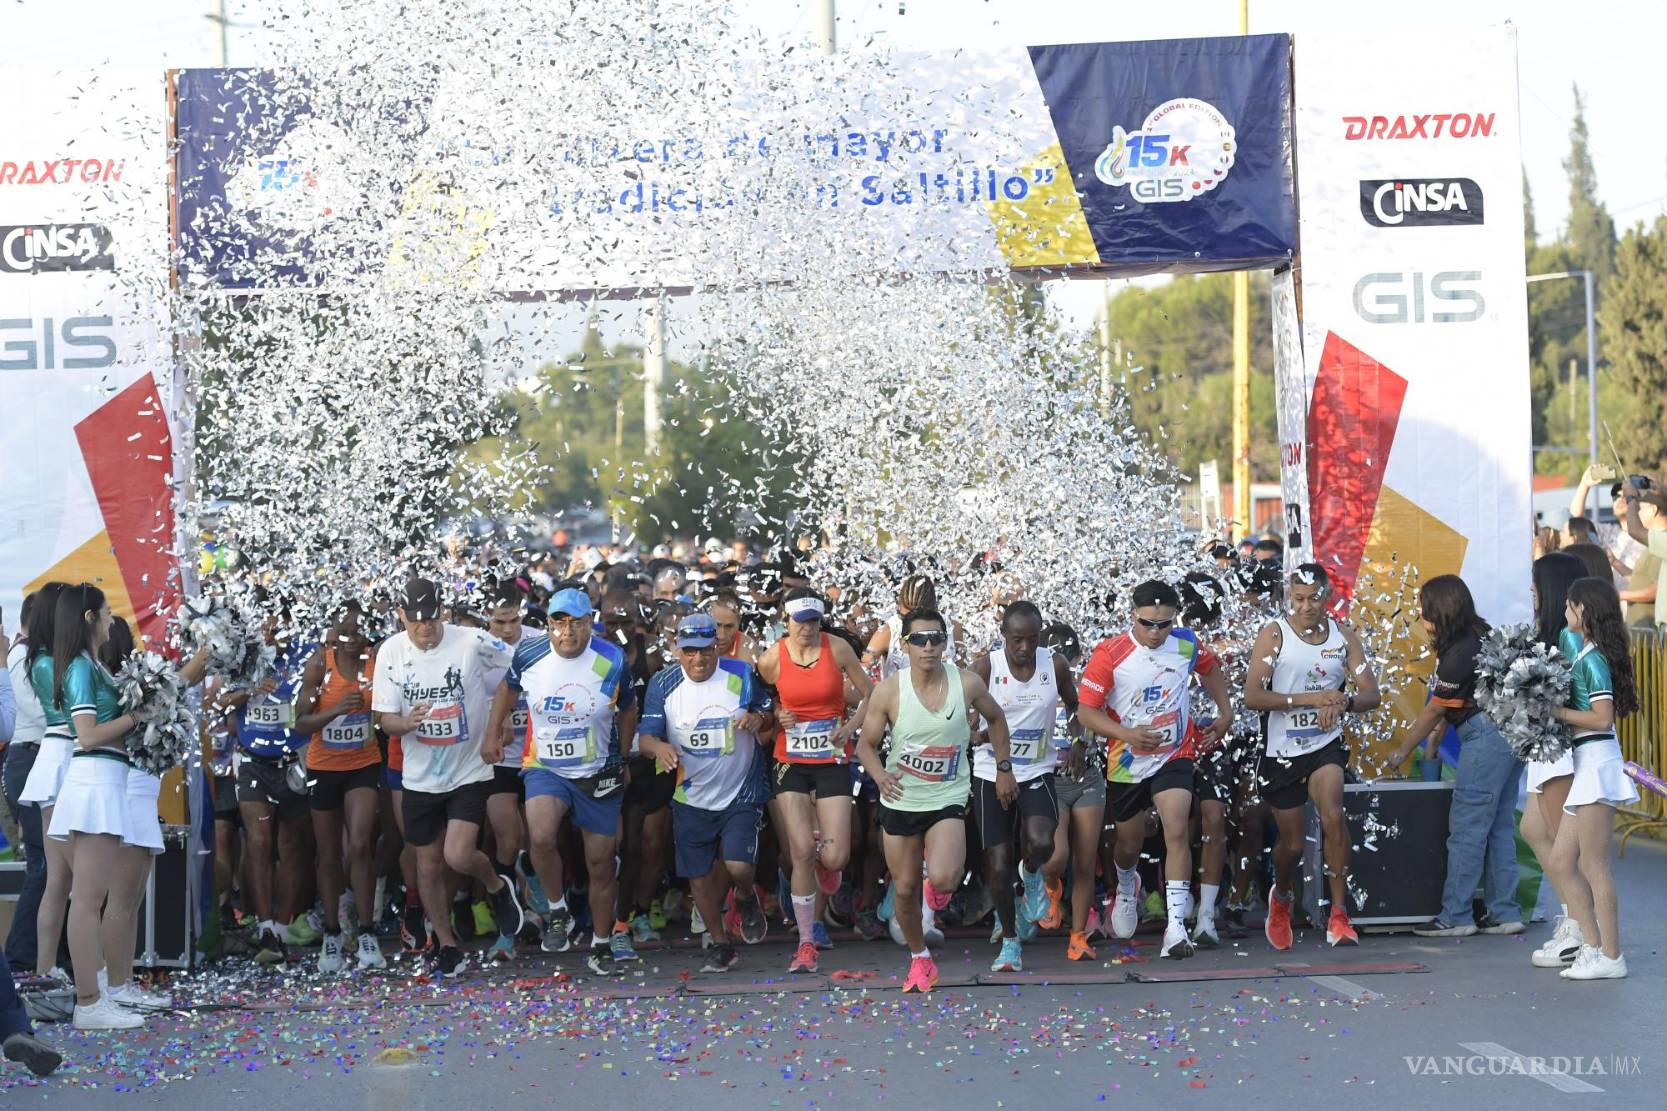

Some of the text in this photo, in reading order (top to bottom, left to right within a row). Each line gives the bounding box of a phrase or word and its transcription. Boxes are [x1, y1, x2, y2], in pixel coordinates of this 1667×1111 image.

[1342, 112, 1496, 141] DRAXTON
[1135, 179, 1184, 198] GIS
[1352, 270, 1486, 324] GIS
[543, 696, 576, 712] 15K
[1145, 703, 1165, 714] GIS
[547, 715, 571, 725] GIS
[326, 727, 363, 741] 1804
[418, 722, 453, 737] 4133
[689, 732, 709, 747] 69
[791, 735, 829, 750] 2102
[546, 743, 575, 757] 150
[900, 754, 945, 773] 4002
[597, 777, 617, 789] NIKE
